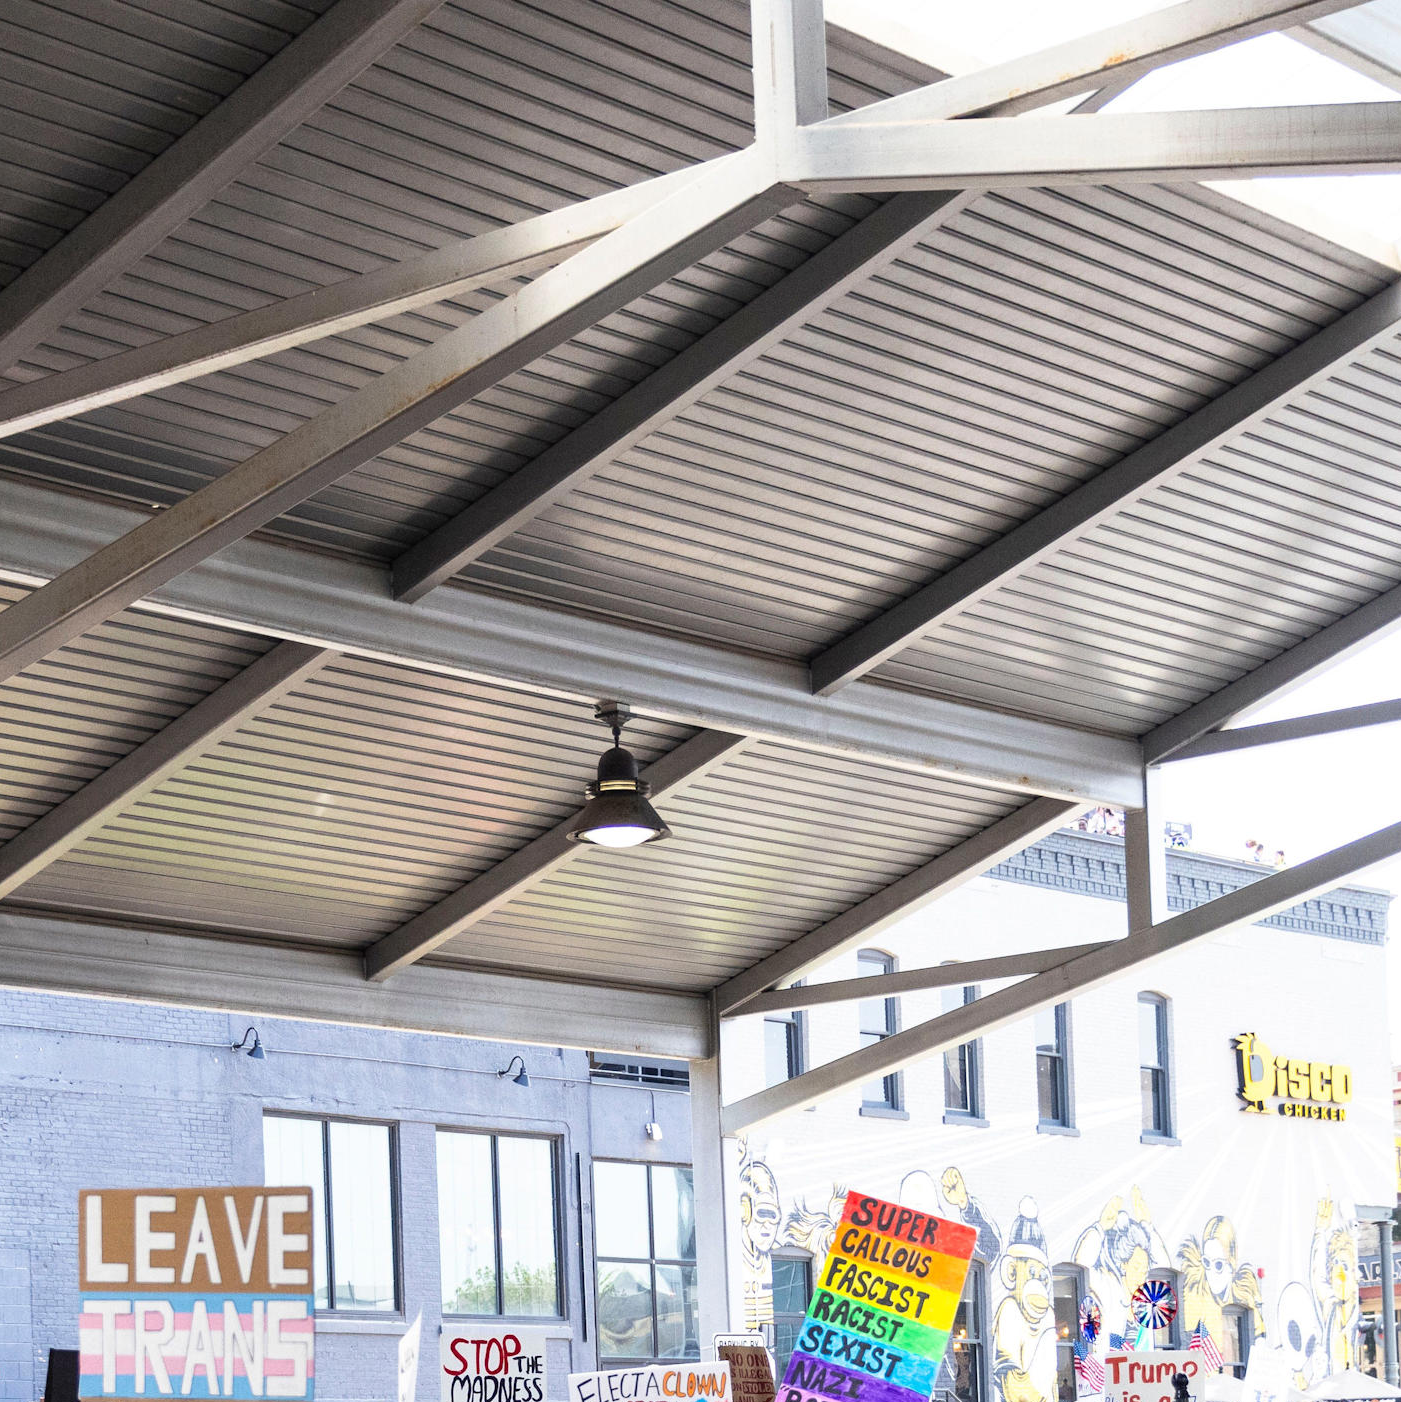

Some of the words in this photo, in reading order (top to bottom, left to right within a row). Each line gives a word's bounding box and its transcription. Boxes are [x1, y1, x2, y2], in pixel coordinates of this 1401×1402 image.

[1283, 1102, 1347, 1121] CHICKEN
[86, 1195, 309, 1285] LEAVE
[850, 1197, 939, 1245] SUPER
[840, 1228, 932, 1278] CALLOUS
[825, 1256, 930, 1319] FASCIST
[812, 1291, 904, 1342] RACIST
[83, 1300, 308, 1396] TRANS
[443, 1334, 522, 1376] STOP
[513, 1355, 543, 1375] THE
[799, 1325, 902, 1378] SEXIST
[647, 1372, 661, 1399] A
[662, 1370, 726, 1399] CLOWN
[789, 1360, 864, 1400] NAZI
